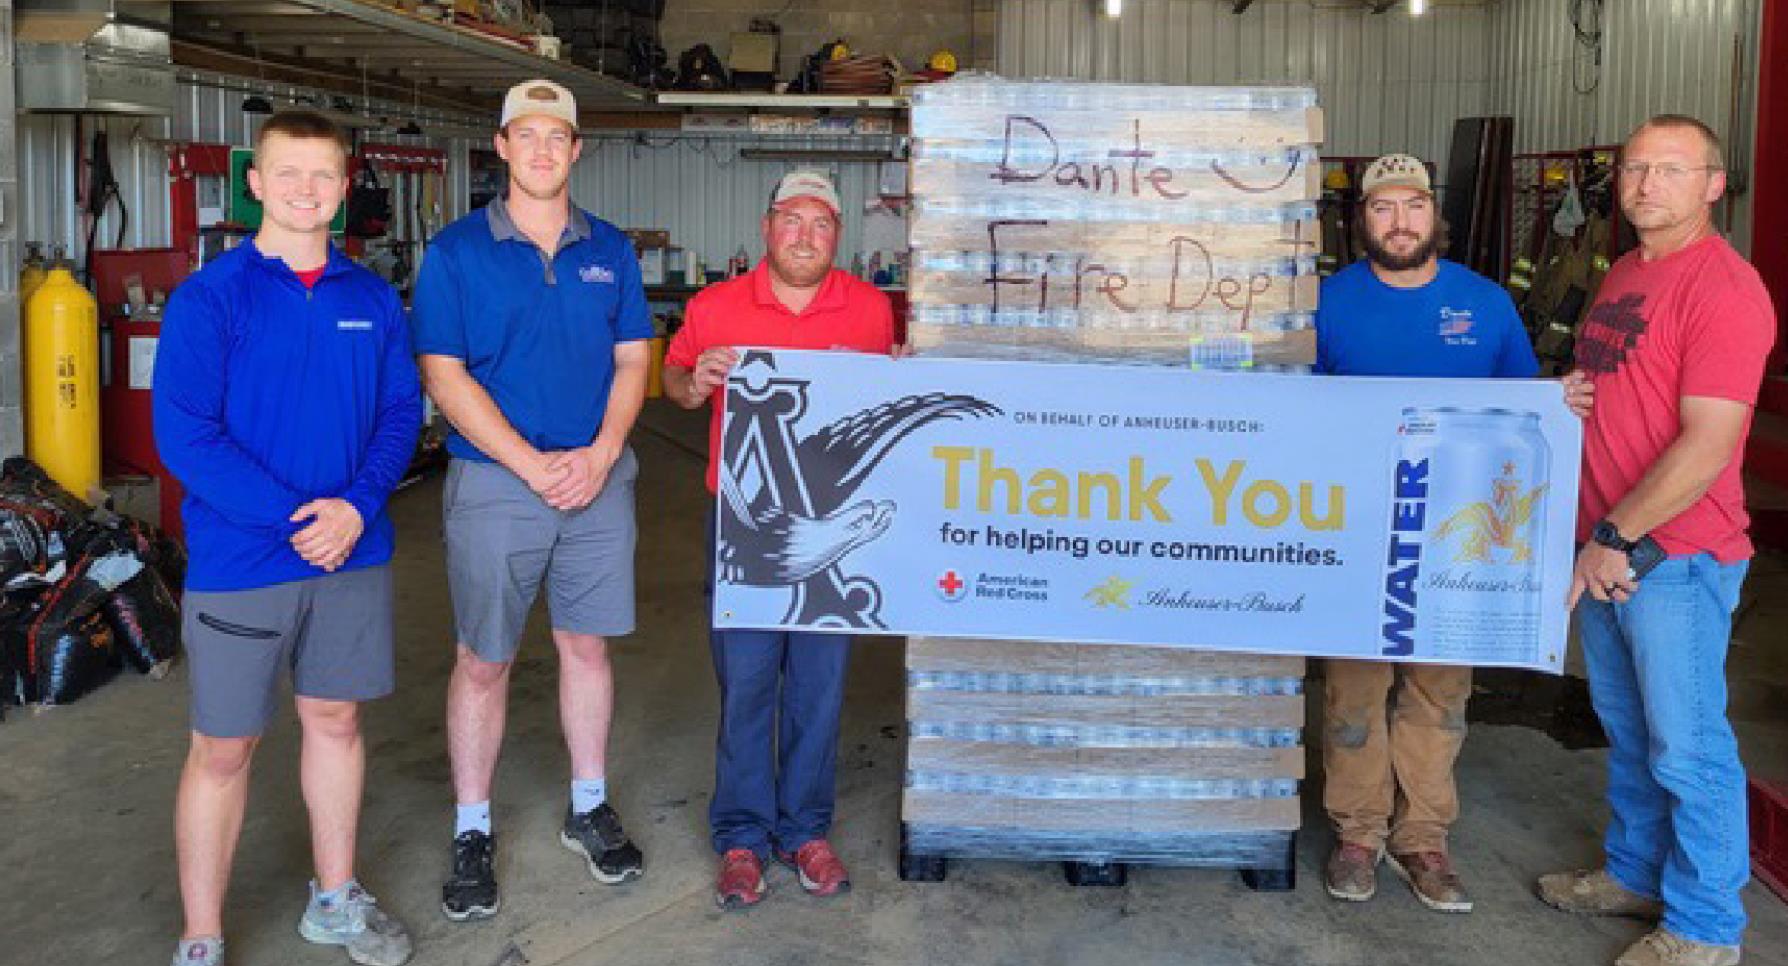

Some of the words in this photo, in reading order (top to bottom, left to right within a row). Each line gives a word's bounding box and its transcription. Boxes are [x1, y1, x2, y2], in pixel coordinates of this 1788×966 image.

[989, 115, 1190, 200] Dante
[982, 220, 1139, 317] Fire
[1167, 219, 1316, 331] Dept
[1014, 411, 1037, 424] ON
[1041, 412, 1093, 428] BEHALF
[1099, 414, 1120, 428] OF
[1124, 416, 1265, 433] ANHEUSER-BUSCH:
[932, 446, 1173, 523] Thank
[1195, 458, 1346, 532] You
[939, 523, 980, 547] for
[986, 526, 1089, 558] helping
[1096, 539, 1141, 557] our
[1150, 540, 1344, 566] communities.
[1382, 457, 1429, 656] WATER
[975, 587, 1005, 600] Red
[1006, 588, 1048, 601] Cross
[976, 573, 1048, 588] American
